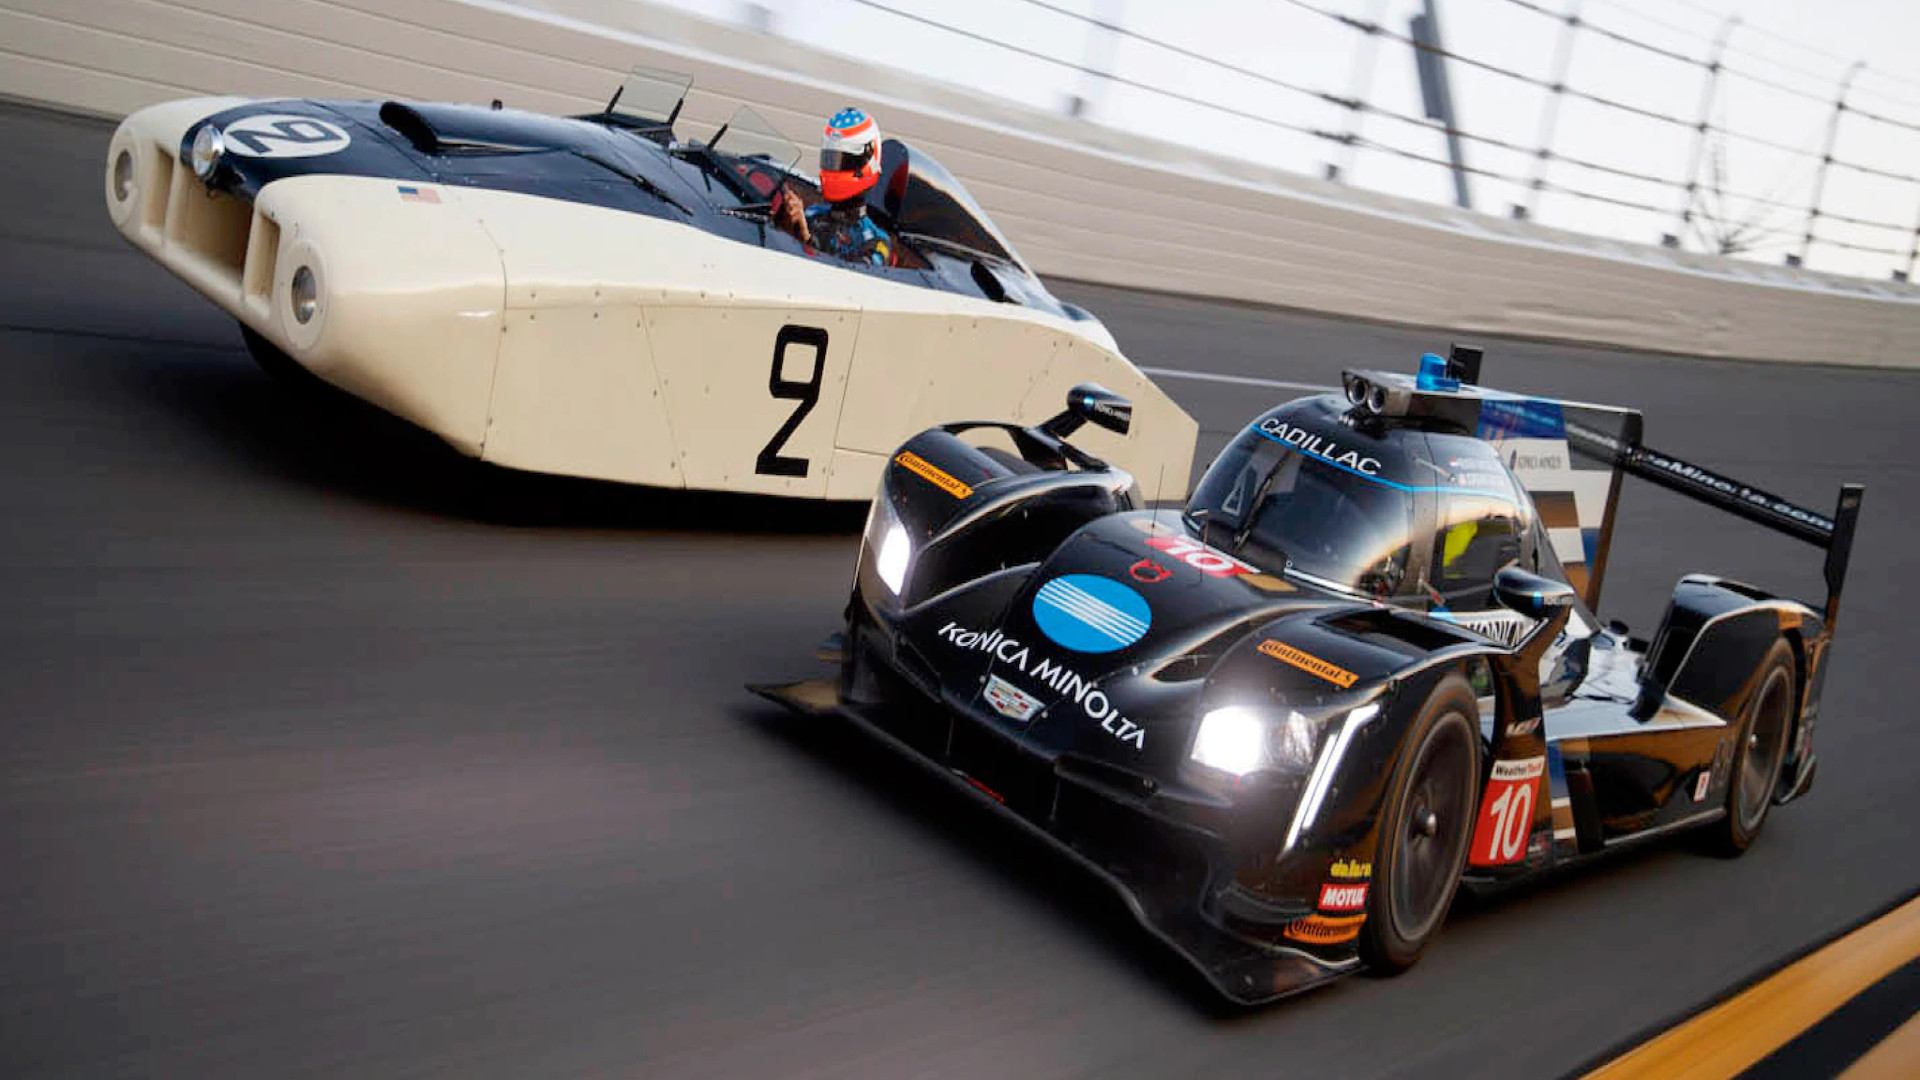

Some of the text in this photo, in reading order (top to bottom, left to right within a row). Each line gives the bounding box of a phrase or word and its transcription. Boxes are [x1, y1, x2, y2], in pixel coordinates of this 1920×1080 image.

[755, 324, 829, 478] 2
[1260, 418, 1382, 475] CADILLAC
[938, 621, 1145, 750] KONICA MINOLTA
[1261, 641, 1341, 679] Continental
[1489, 783, 1532, 861] 10
[1322, 887, 1365, 906] MOTUL
